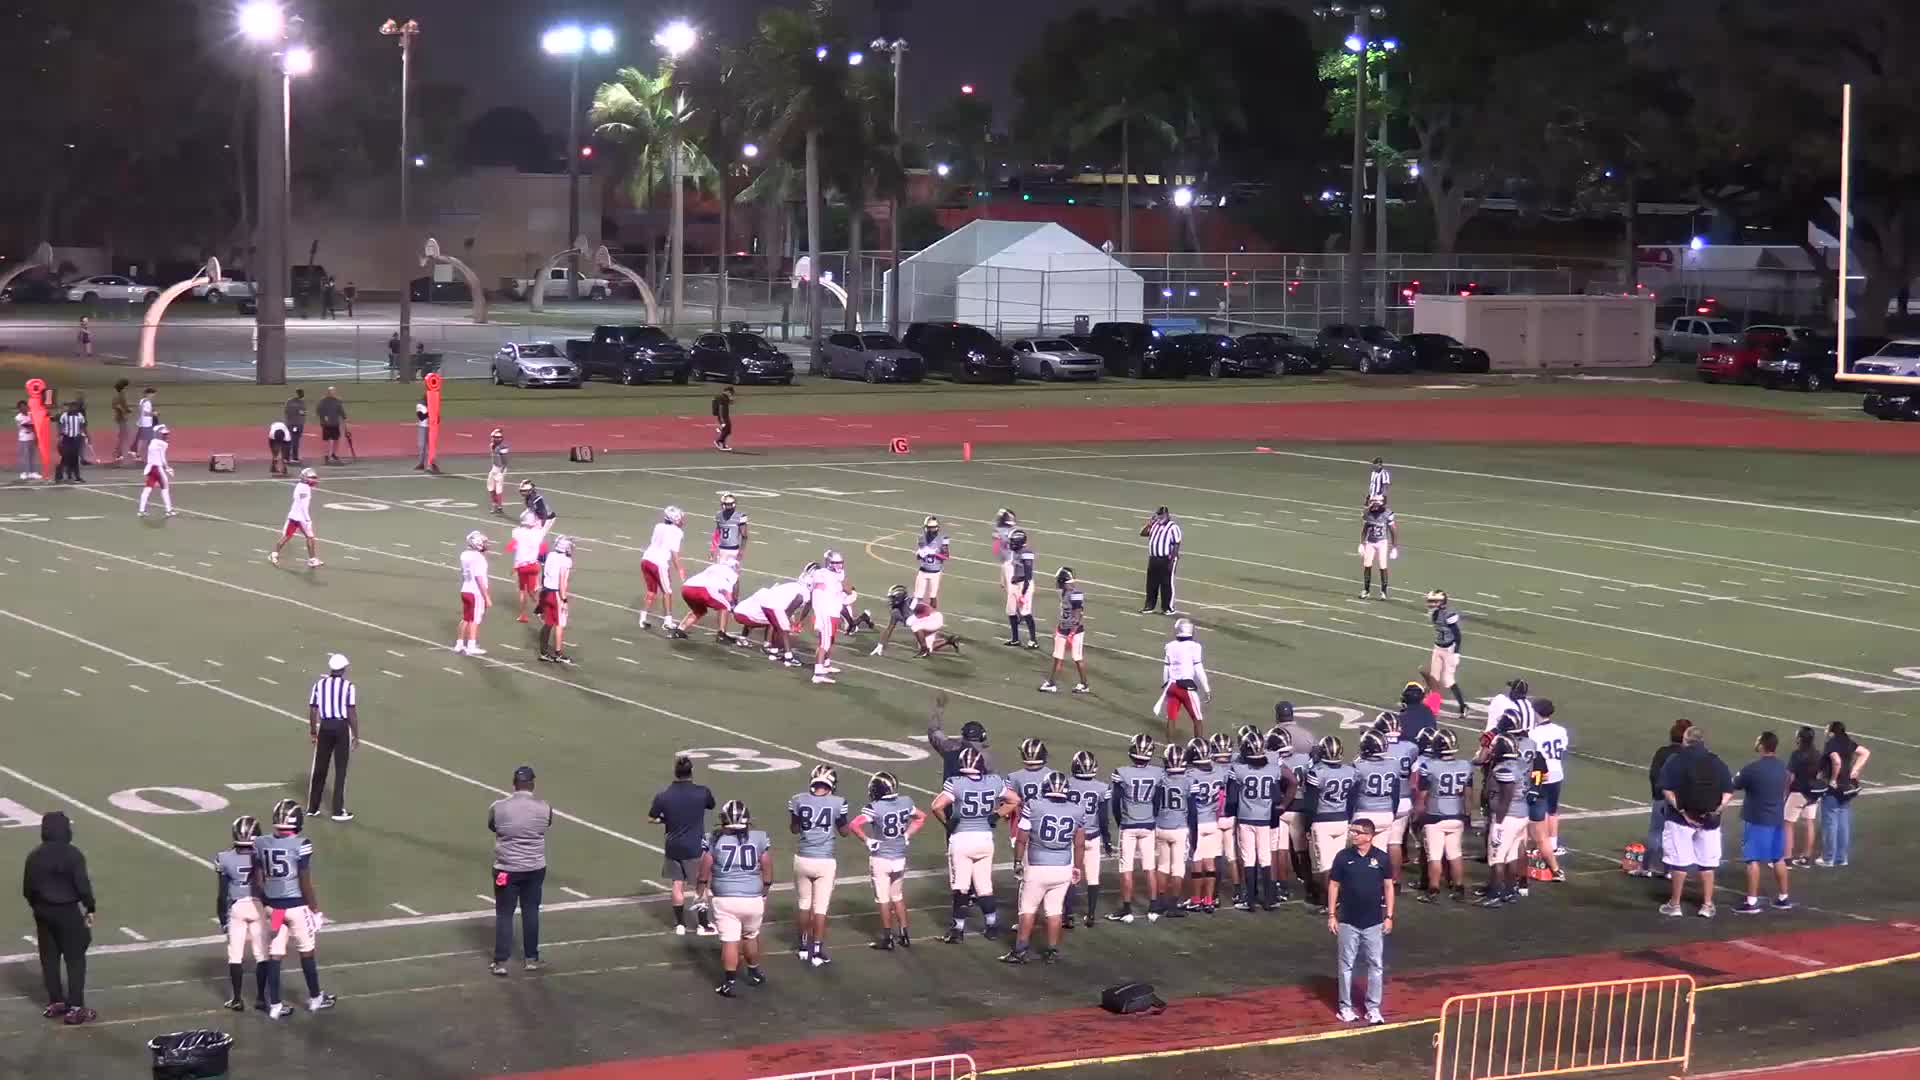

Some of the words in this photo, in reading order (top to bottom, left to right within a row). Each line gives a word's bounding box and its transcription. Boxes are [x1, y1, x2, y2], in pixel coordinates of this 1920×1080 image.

[575, 446, 591, 461] 10
[895, 439, 908, 451] G
[674, 738, 930, 772] 30
[1131, 778, 1156, 801] 17
[1243, 775, 1274, 799] 80
[1323, 777, 1354, 802] 28
[1367, 772, 1398, 797] 93
[1438, 771, 1468, 796] 95
[961, 790, 995, 818] 55
[1160, 784, 1183, 810] 16
[798, 805, 833, 833] 84
[882, 807, 910, 839] 85
[1040, 814, 1074, 843] 62
[263, 848, 290, 878] 15
[720, 843, 758, 873] 70
